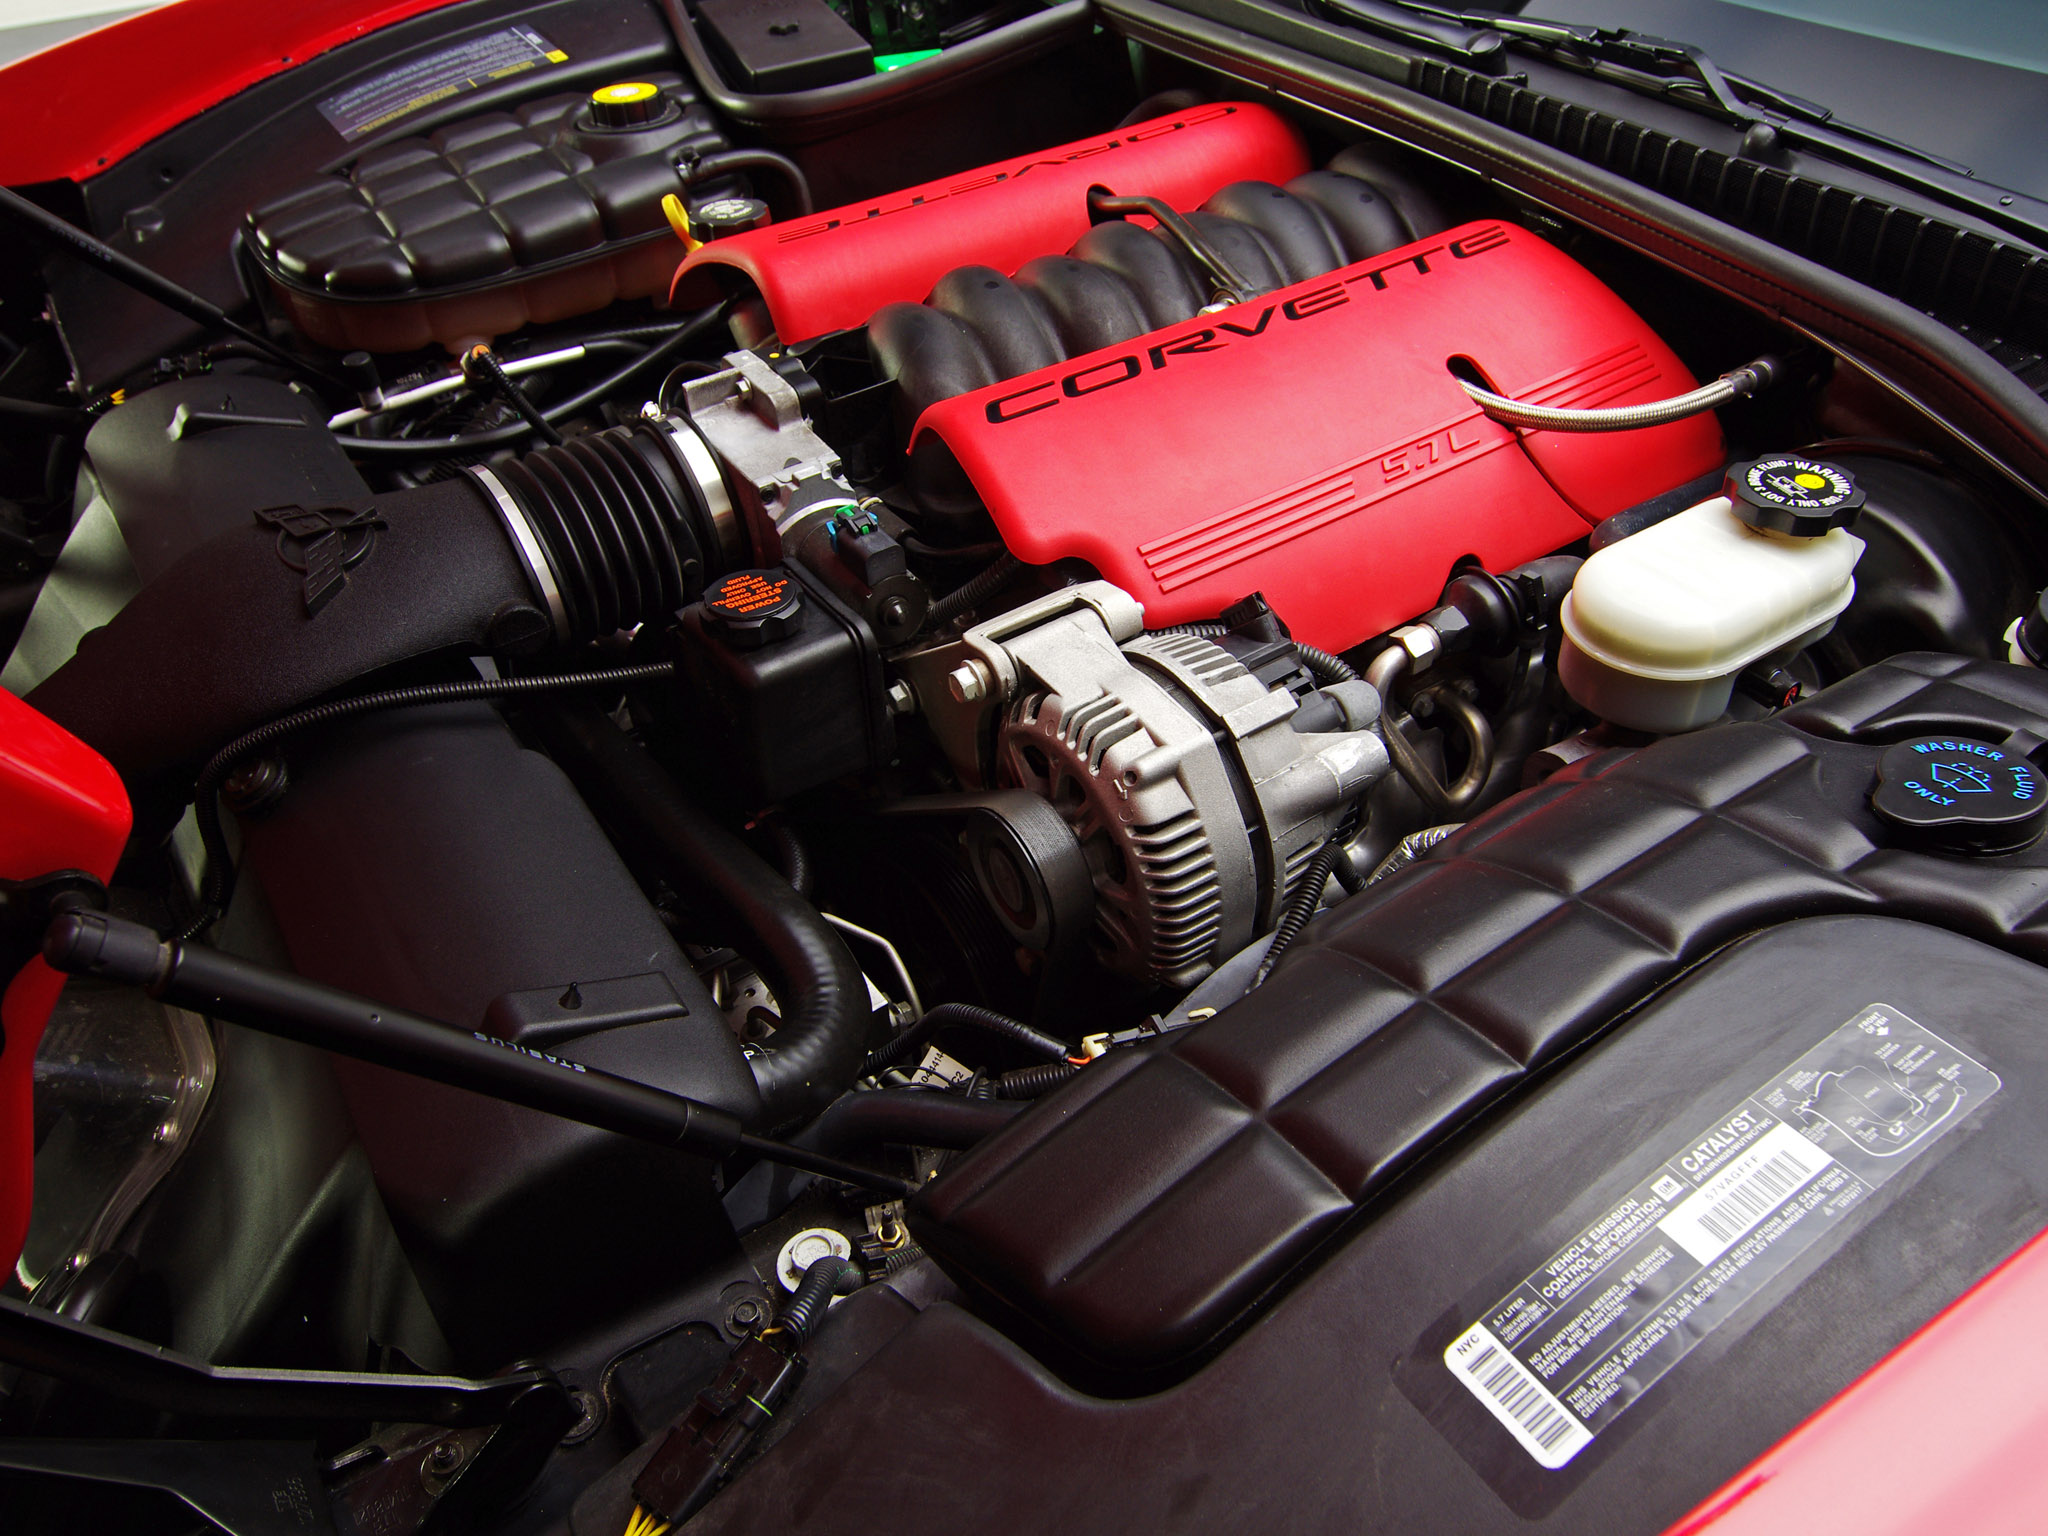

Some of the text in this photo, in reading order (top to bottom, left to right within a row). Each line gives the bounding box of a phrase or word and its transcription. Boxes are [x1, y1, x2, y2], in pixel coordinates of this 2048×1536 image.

[778, 107, 1237, 243] CORVETTE
[985, 226, 1511, 424] CORVETTE
[1756, 459, 1788, 471] FLUID
[1793, 460, 1852, 495] WARNING
[1760, 492, 1786, 503] DOT
[1786, 499, 1820, 508] ONLY
[1818, 494, 1845, 506] USE
[711, 579, 788, 607] DO NOT OVERFILL
[720, 576, 763, 593] APPROVED
[726, 574, 751, 585] FLUID
[726, 581, 768, 598] USE ONLY
[725, 588, 782, 609] STEERING
[738, 596, 782, 613] POWER
[1910, 741, 2036, 800] WASHER FLUID
[1904, 781, 1957, 806] ONLY
[1857, 1010, 1882, 1029] FRONT
[1864, 1015, 1889, 1034] OF VEH
[473, 1031, 586, 1073] STABILUS
[1678, 1108, 1759, 1174] CATALYST
[1657, 1180, 1677, 1196] GM
[1540, 1195, 1664, 1298] CONTROL INFORMATION
[1544, 1197, 1640, 1277] VEHICLE EMISSION
[1555, 1205, 1667, 1300] GENERAL MOTORS CORPORATION
[1564, 1165, 1843, 1405] THIS VEHICLE CONFORMS TO U.S. EPA NLEV REGULATIONS AND CALIFORNIA
[1572, 1364, 1627, 1412] REGULATIONS
[1620, 1326, 1670, 1369] APPLICABLE
[1664, 1316, 1679, 1329] TO
[1674, 1303, 1695, 1320] 2001
[1690, 1264, 1739, 1306] MODEL-YEAR
[1734, 1250, 1756, 1268] NEW
[1751, 1239, 1769, 1254] LEV
[1764, 1206, 1808, 1243] PASSENGER
[1802, 1189, 1828, 1211] CARS.
[1824, 1176, 1844, 1192] OBD
[1491, 1296, 1527, 1328] 5.7 LITER
[1527, 1244, 1668, 1366] NO ADJUSTMENTS NEEDED. SEE SERVICE
[1533, 1250, 1675, 1372] MANUAL AND MAINTENANCE SCHEDULE
[1455, 1333, 1481, 1356] NYC
[1541, 1301, 1631, 1380] FOR MORE INFORMATION.
[1579, 1380, 1623, 1419] CERTIFIED.
